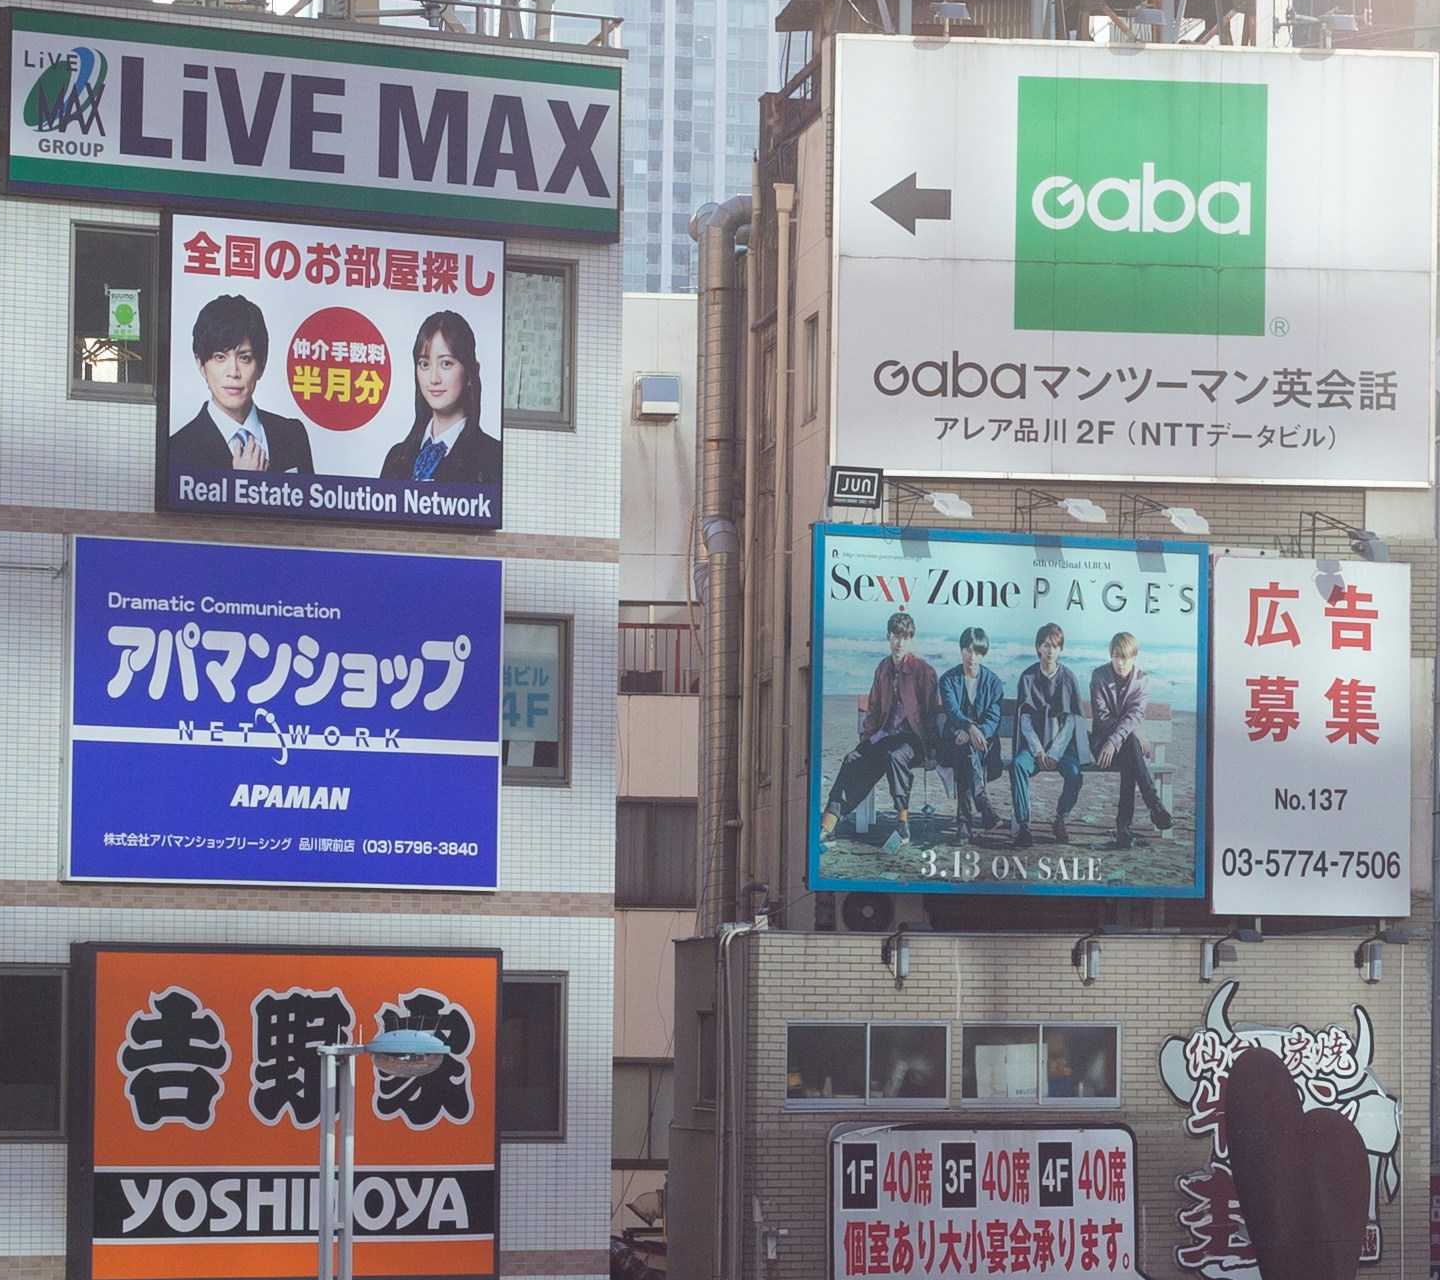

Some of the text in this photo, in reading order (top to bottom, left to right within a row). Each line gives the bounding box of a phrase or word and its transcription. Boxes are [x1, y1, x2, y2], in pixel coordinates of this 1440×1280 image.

[38, 138, 105, 158] GROUP
[377, 82, 611, 199] MAX
[182, 230, 496, 298] 全国のお部屋探し
[292, 338, 386, 366] 仲介手数料
[291, 365, 385, 406] 半月分
[933, 417, 1116, 445] アレア品川 2F
[179, 475, 492, 518] Real Estate Solution Network
[840, 477, 871, 494] JUN
[107, 592, 342, 620] Dramatic Communication
[830, 563, 1021, 612] Sexy Zone
[1243, 581, 1380, 651] 広告
[106, 621, 472, 711] アパマンショップ
[1244, 674, 1381, 746] 募集
[229, 783, 351, 811] APAMAN
[1274, 787, 1349, 812] No.137
[298, 837, 356, 854] 品川駅前店
[920, 848, 1103, 882] 3.13 ON SALE
[1221, 847, 1402, 880] 03-5774-7506
[116, 985, 475, 1132] 吉野家
[845, 1147, 1127, 1206] 1F 40席 3F 40席 4F 40席
[843, 1217, 1131, 1276] 個室あり大小宴会承ります。
